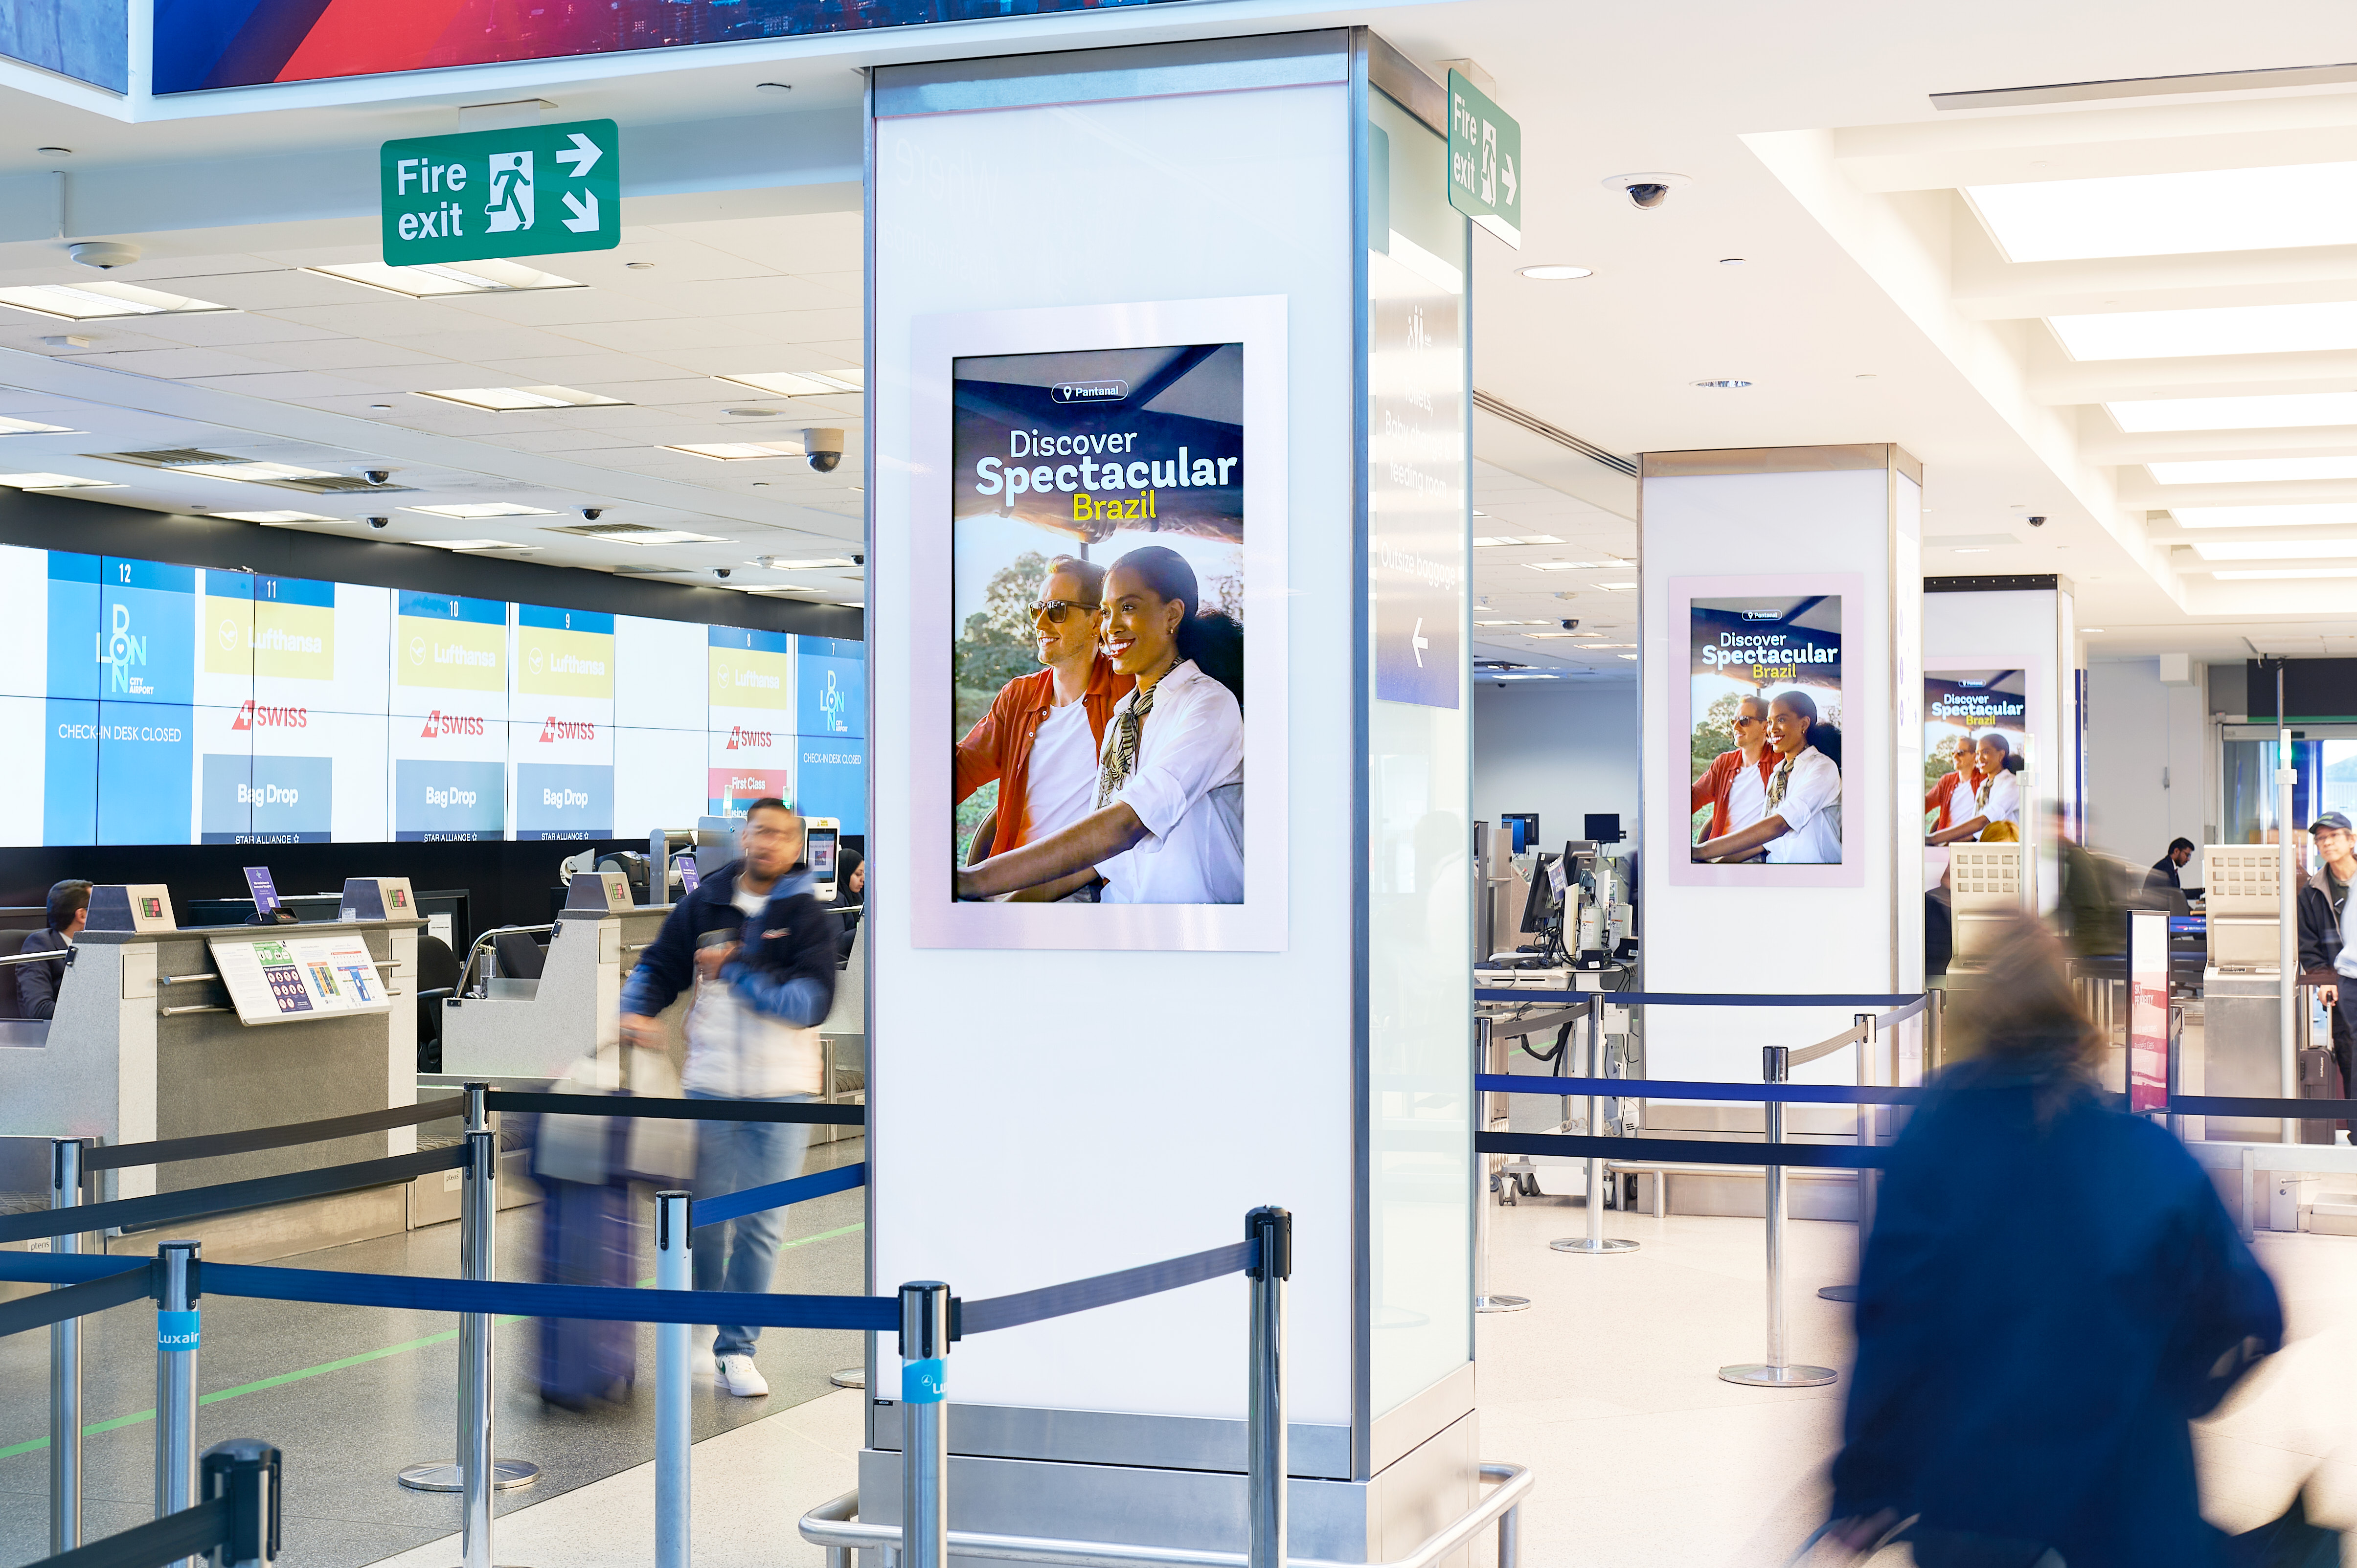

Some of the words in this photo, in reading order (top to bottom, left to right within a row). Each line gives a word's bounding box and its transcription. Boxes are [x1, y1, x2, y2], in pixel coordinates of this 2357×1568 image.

[1454, 92, 1477, 146] Fire
[397, 157, 467, 196] Fire
[1454, 151, 1475, 194] exit
[398, 201, 463, 241] exit
[1075, 385, 1119, 397] Pantanal
[1404, 376, 1433, 417] Toilets,
[1010, 428, 1138, 458] Discover
[1386, 410, 1408, 448] Baby
[1410, 423, 1442, 462] change
[1445, 436, 1450, 461] &
[975, 446, 1238, 507] Spectacular
[1390, 455, 1423, 497] feeding
[1425, 475, 1447, 500] room
[1073, 490, 1156, 521] Brazil
[119, 563, 131, 583] 12
[1381, 541, 1414, 574] Outsize
[1417, 551, 1455, 591] baggage
[267, 580, 276, 598] 11
[450, 600, 458, 617] 10
[566, 613, 570, 629] 9
[248, 626, 322, 653] Lufthansa
[747, 633, 751, 647] 8
[832, 642, 835, 655] 7
[1720, 632, 1787, 647] Discover
[434, 643, 496, 667] Lufthansa
[550, 653, 605, 675] Lufthansa
[1702, 642, 1838, 671] Spectacular
[735, 669, 780, 689] Lufthansa
[1753, 663, 1796, 678] Brazil
[129, 677, 143, 685] CITY
[129, 686, 154, 694] AIRPORT
[1944, 693, 1990, 705] Discover
[257, 706, 307, 728] SWISS
[1931, 700, 2024, 720] Spectacular
[1966, 714, 1995, 725] Brazil
[58, 724, 111, 739] CHECK-IN
[114, 726, 139, 740] DESK
[141, 727, 181, 742] CLOSED
[442, 715, 483, 735] SWISS
[558, 721, 594, 740] SWISS
[742, 730, 771, 747] SWISS
[803, 753, 828, 763] CHECK-IN
[829, 754, 841, 764] DESK
[842, 754, 861, 764] CLOSED
[732, 777, 747, 789] First
[748, 777, 766, 790] Class
[238, 784, 264, 807] Bag
[266, 784, 298, 807] Drop
[426, 786, 448, 808] Bag
[450, 786, 476, 808] Drop
[544, 788, 563, 808] Bag
[564, 788, 588, 808] Drop
[235, 835, 254, 844] STAR
[256, 835, 291, 844] ALLIANCE
[424, 833, 439, 842] STAR
[441, 833, 470, 842] ALLIANCE
[2134, 984, 2143, 994] SKY
[31, 1242, 49, 1252] pteris
[159, 1330, 199, 1344] Luxair
